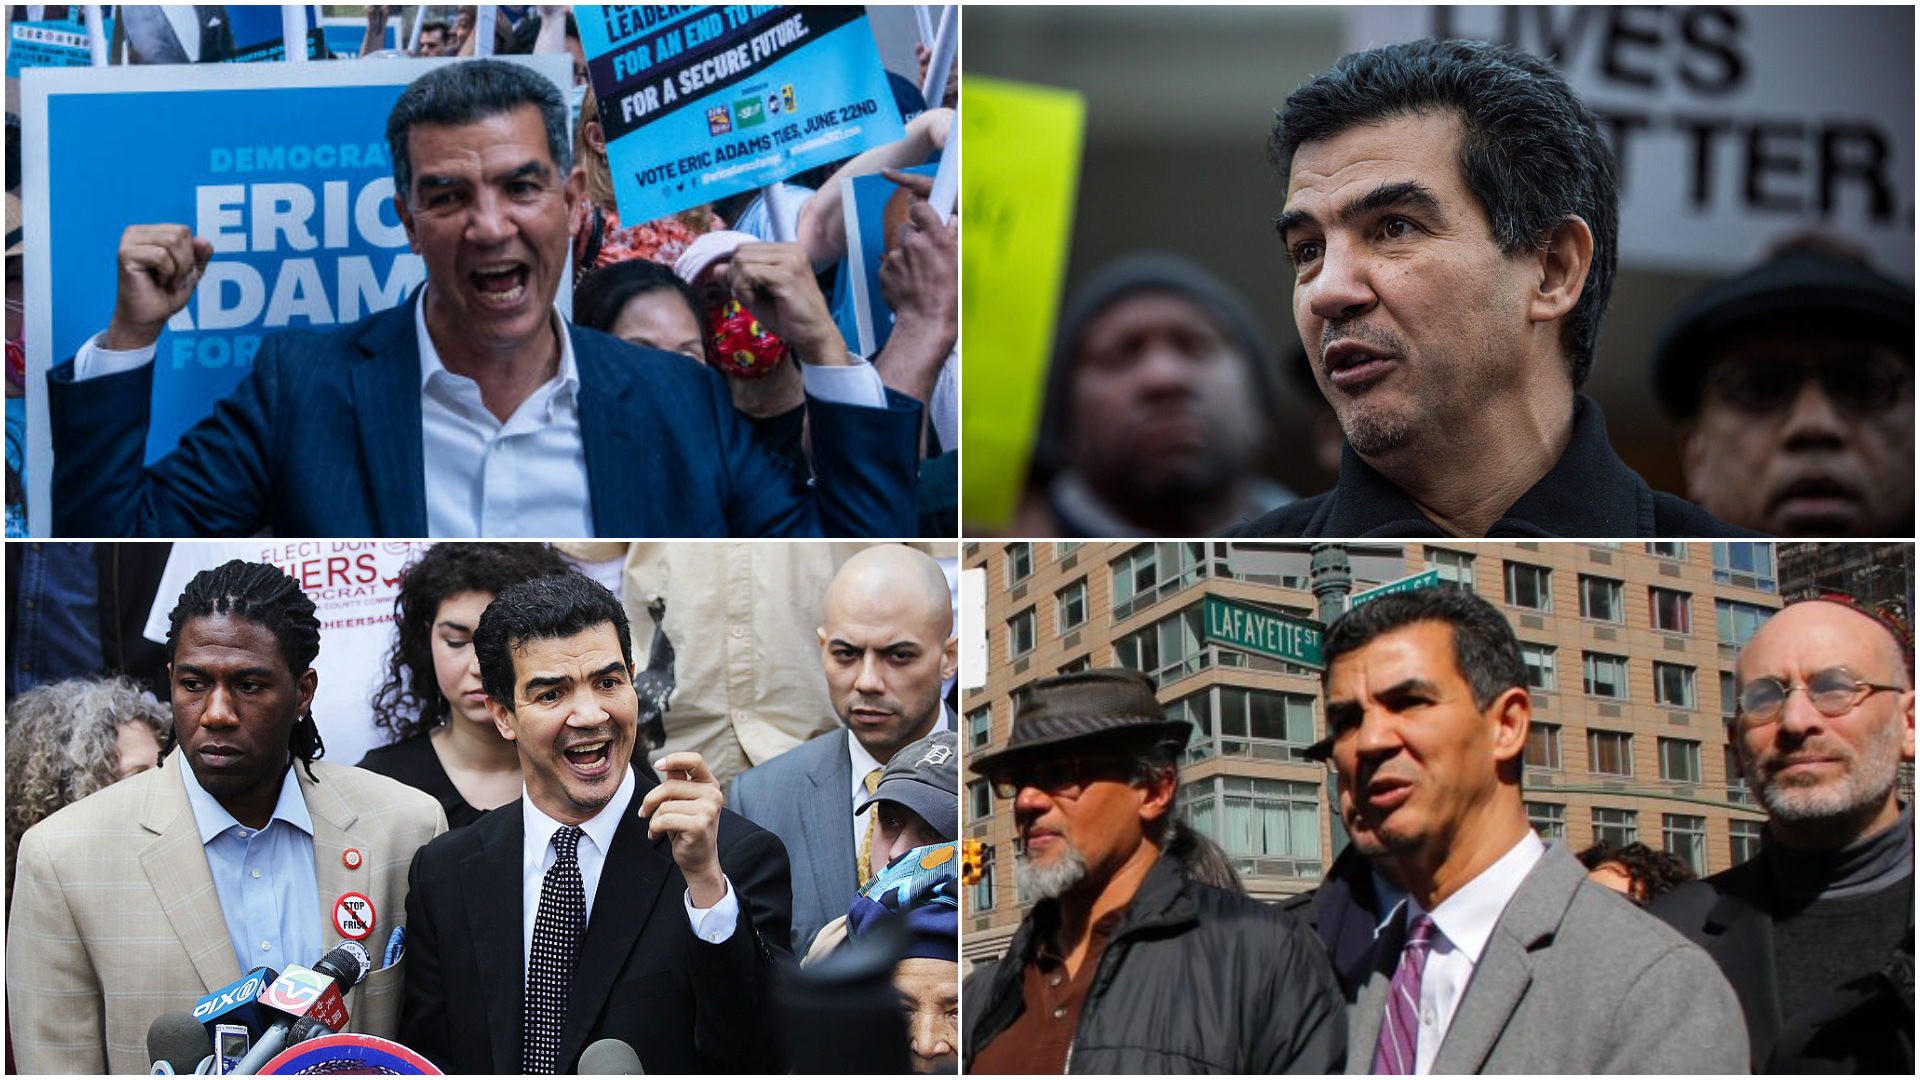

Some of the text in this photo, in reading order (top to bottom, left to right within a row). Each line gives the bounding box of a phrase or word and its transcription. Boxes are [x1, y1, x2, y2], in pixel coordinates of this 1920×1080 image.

[613, 5, 749, 82] FOR AN END TO
[620, 85, 660, 123] FOR
[663, 77, 678, 105] A
[679, 43, 752, 95] SECURE
[750, 13, 809, 62] FUTURE.
[210, 143, 391, 173] DEMOCRA
[635, 162, 677, 187] VOTE
[678, 151, 712, 175] ERIC
[715, 134, 771, 163] ADAMS
[804, 110, 839, 135] JUNE
[839, 99, 877, 122] 22ND
[196, 176, 412, 254] ERIC
[171, 335, 261, 369] FOR
[1211, 603, 1320, 657] LAFAYETTE ST
[343, 920, 368, 930] FRISK
[344, 901, 365, 911] STOP
[352, 911, 358, 920] &
